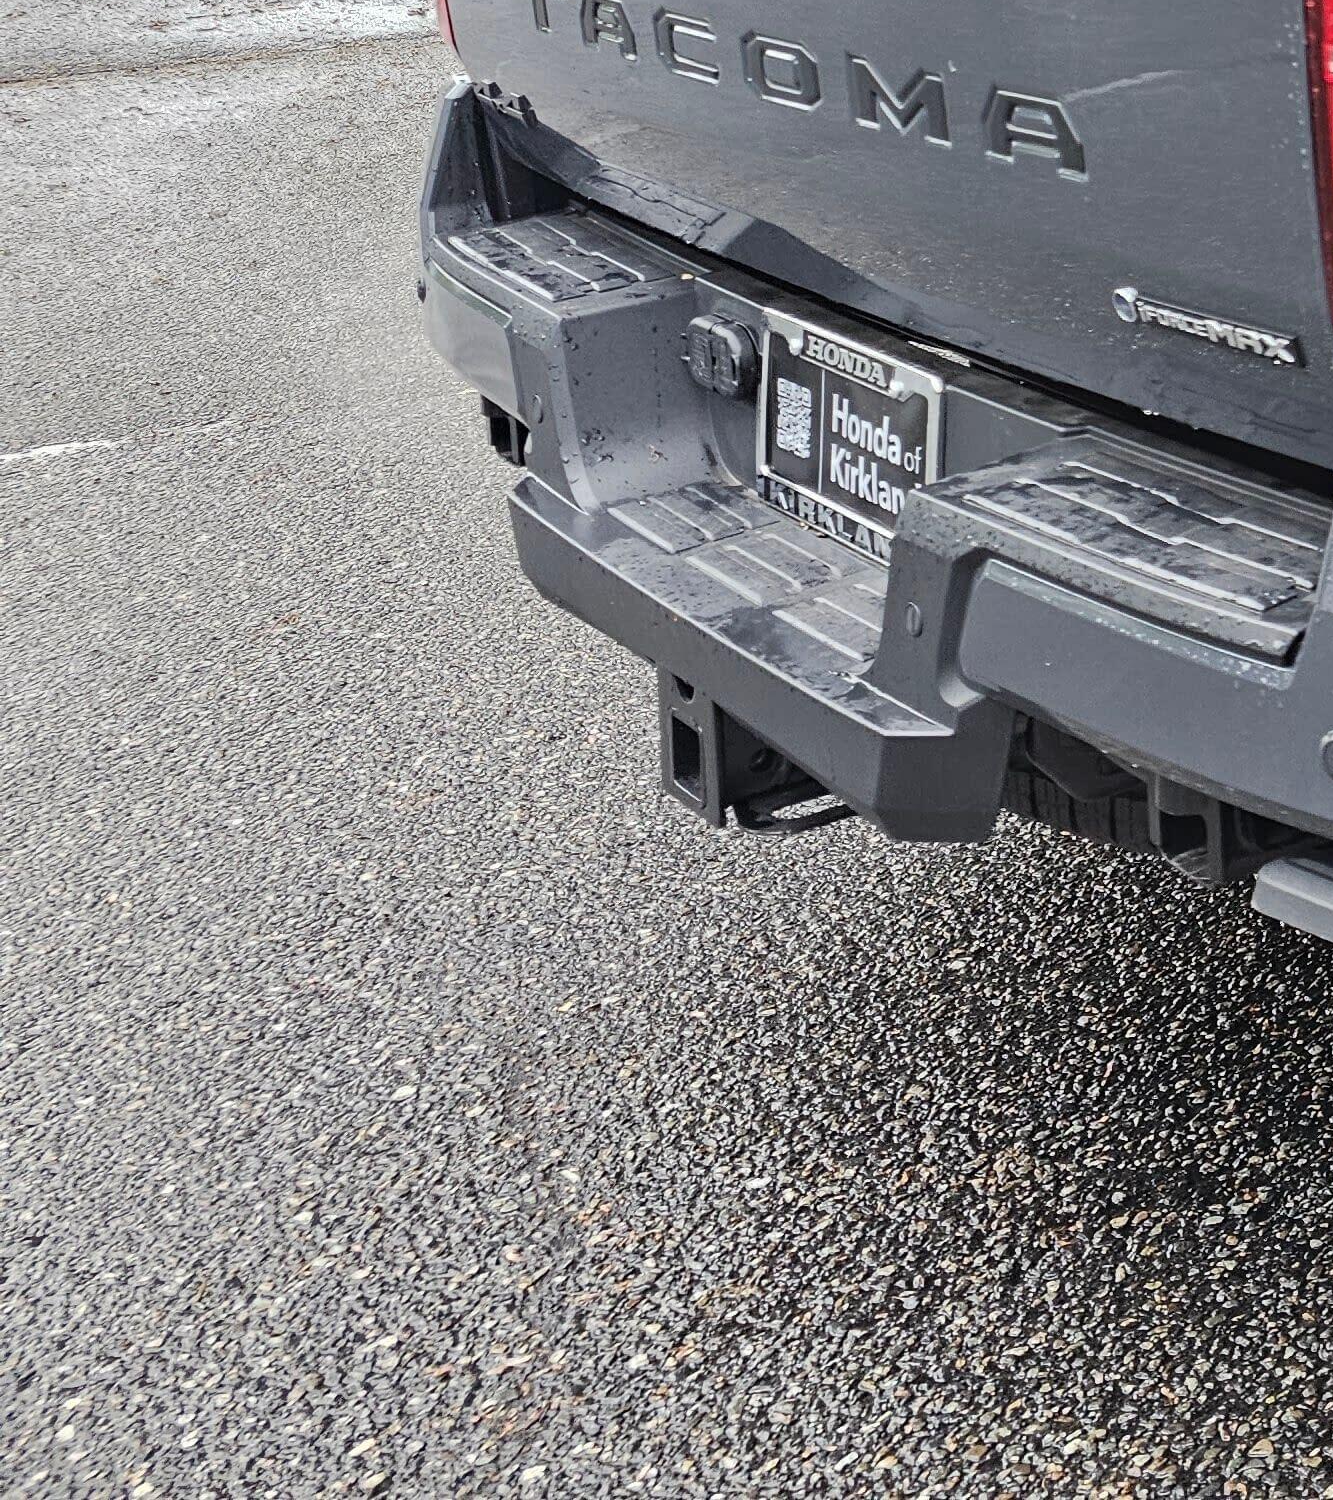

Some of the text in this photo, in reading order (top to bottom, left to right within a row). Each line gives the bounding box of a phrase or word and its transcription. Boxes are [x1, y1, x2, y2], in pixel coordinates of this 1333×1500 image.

[806, 336, 888, 387] HONDA
[831, 393, 922, 475] Honda of
